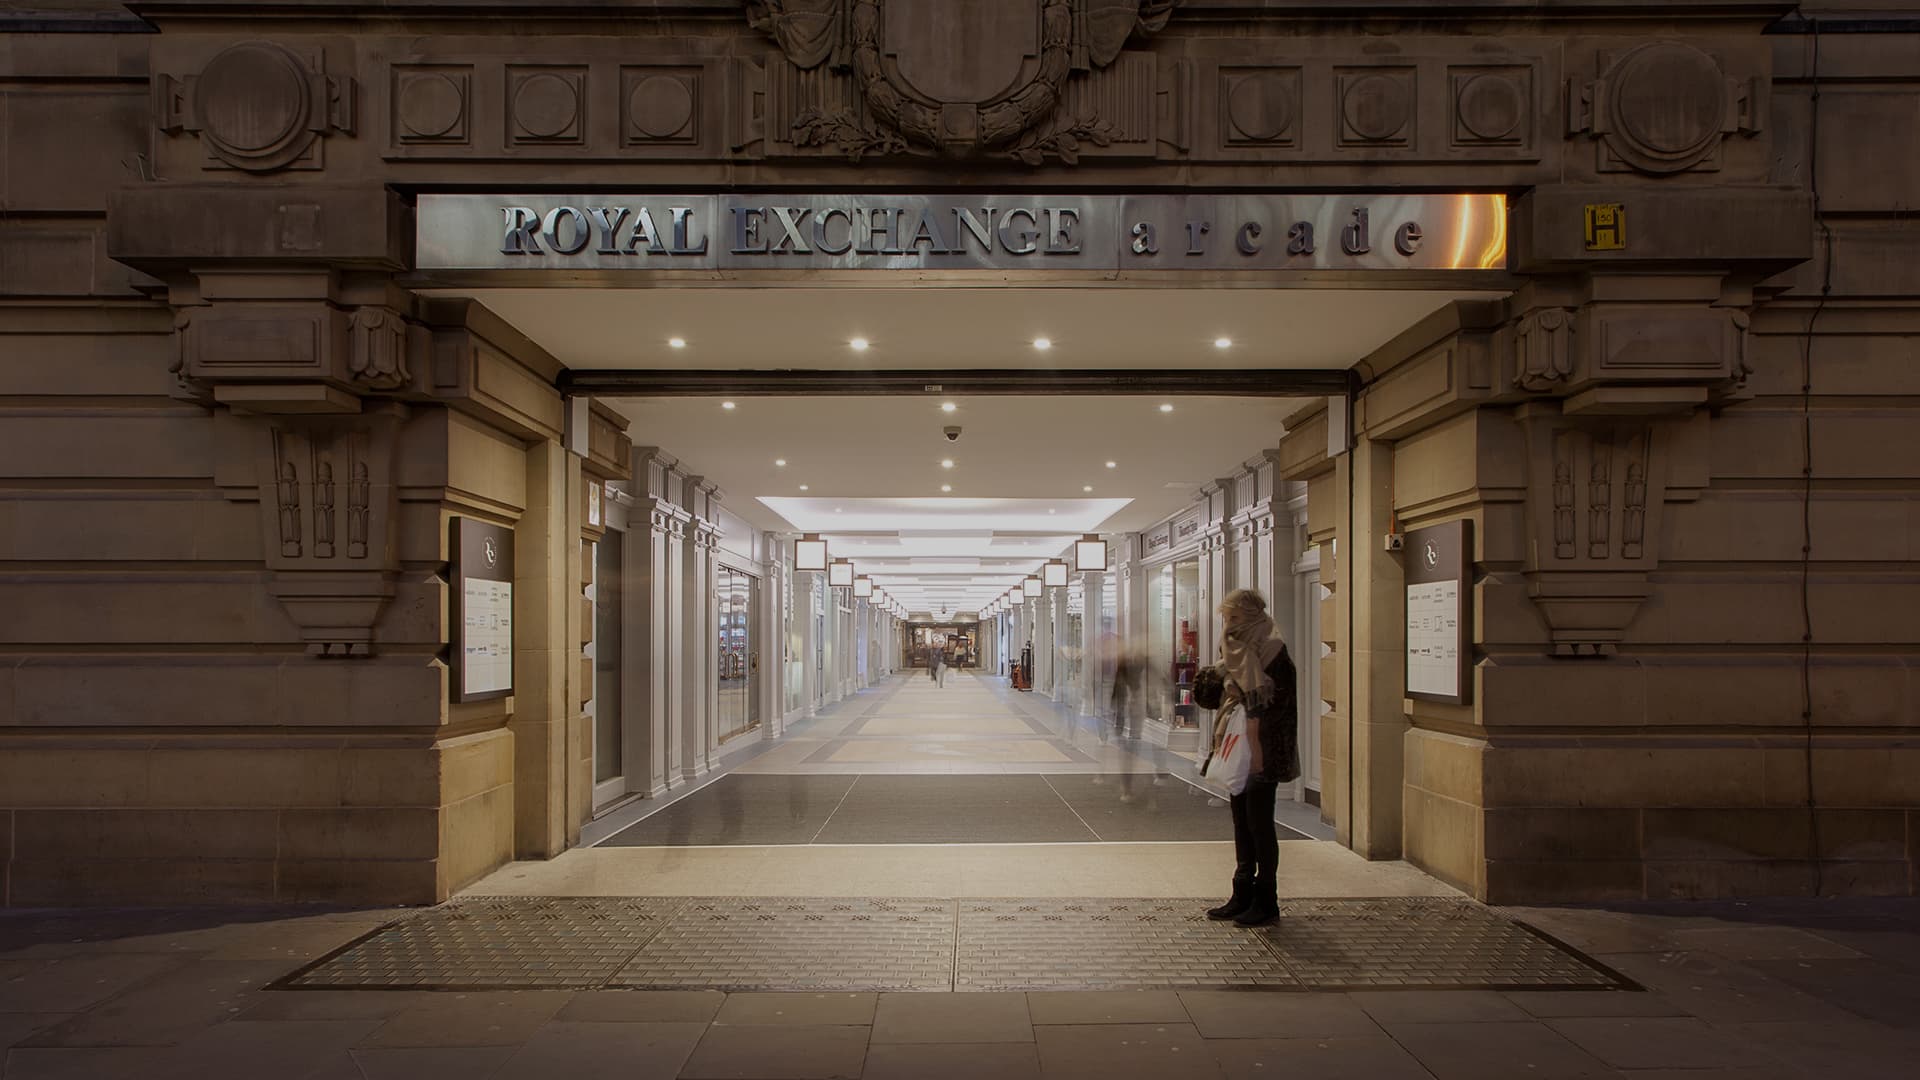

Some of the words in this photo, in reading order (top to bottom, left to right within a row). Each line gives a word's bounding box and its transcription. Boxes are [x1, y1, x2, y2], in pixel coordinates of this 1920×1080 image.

[500, 207, 709, 256] ROYAL
[730, 207, 1083, 256] EXCHANGE
[1131, 207, 1423, 256] arcade
[1591, 209, 1619, 245] H
